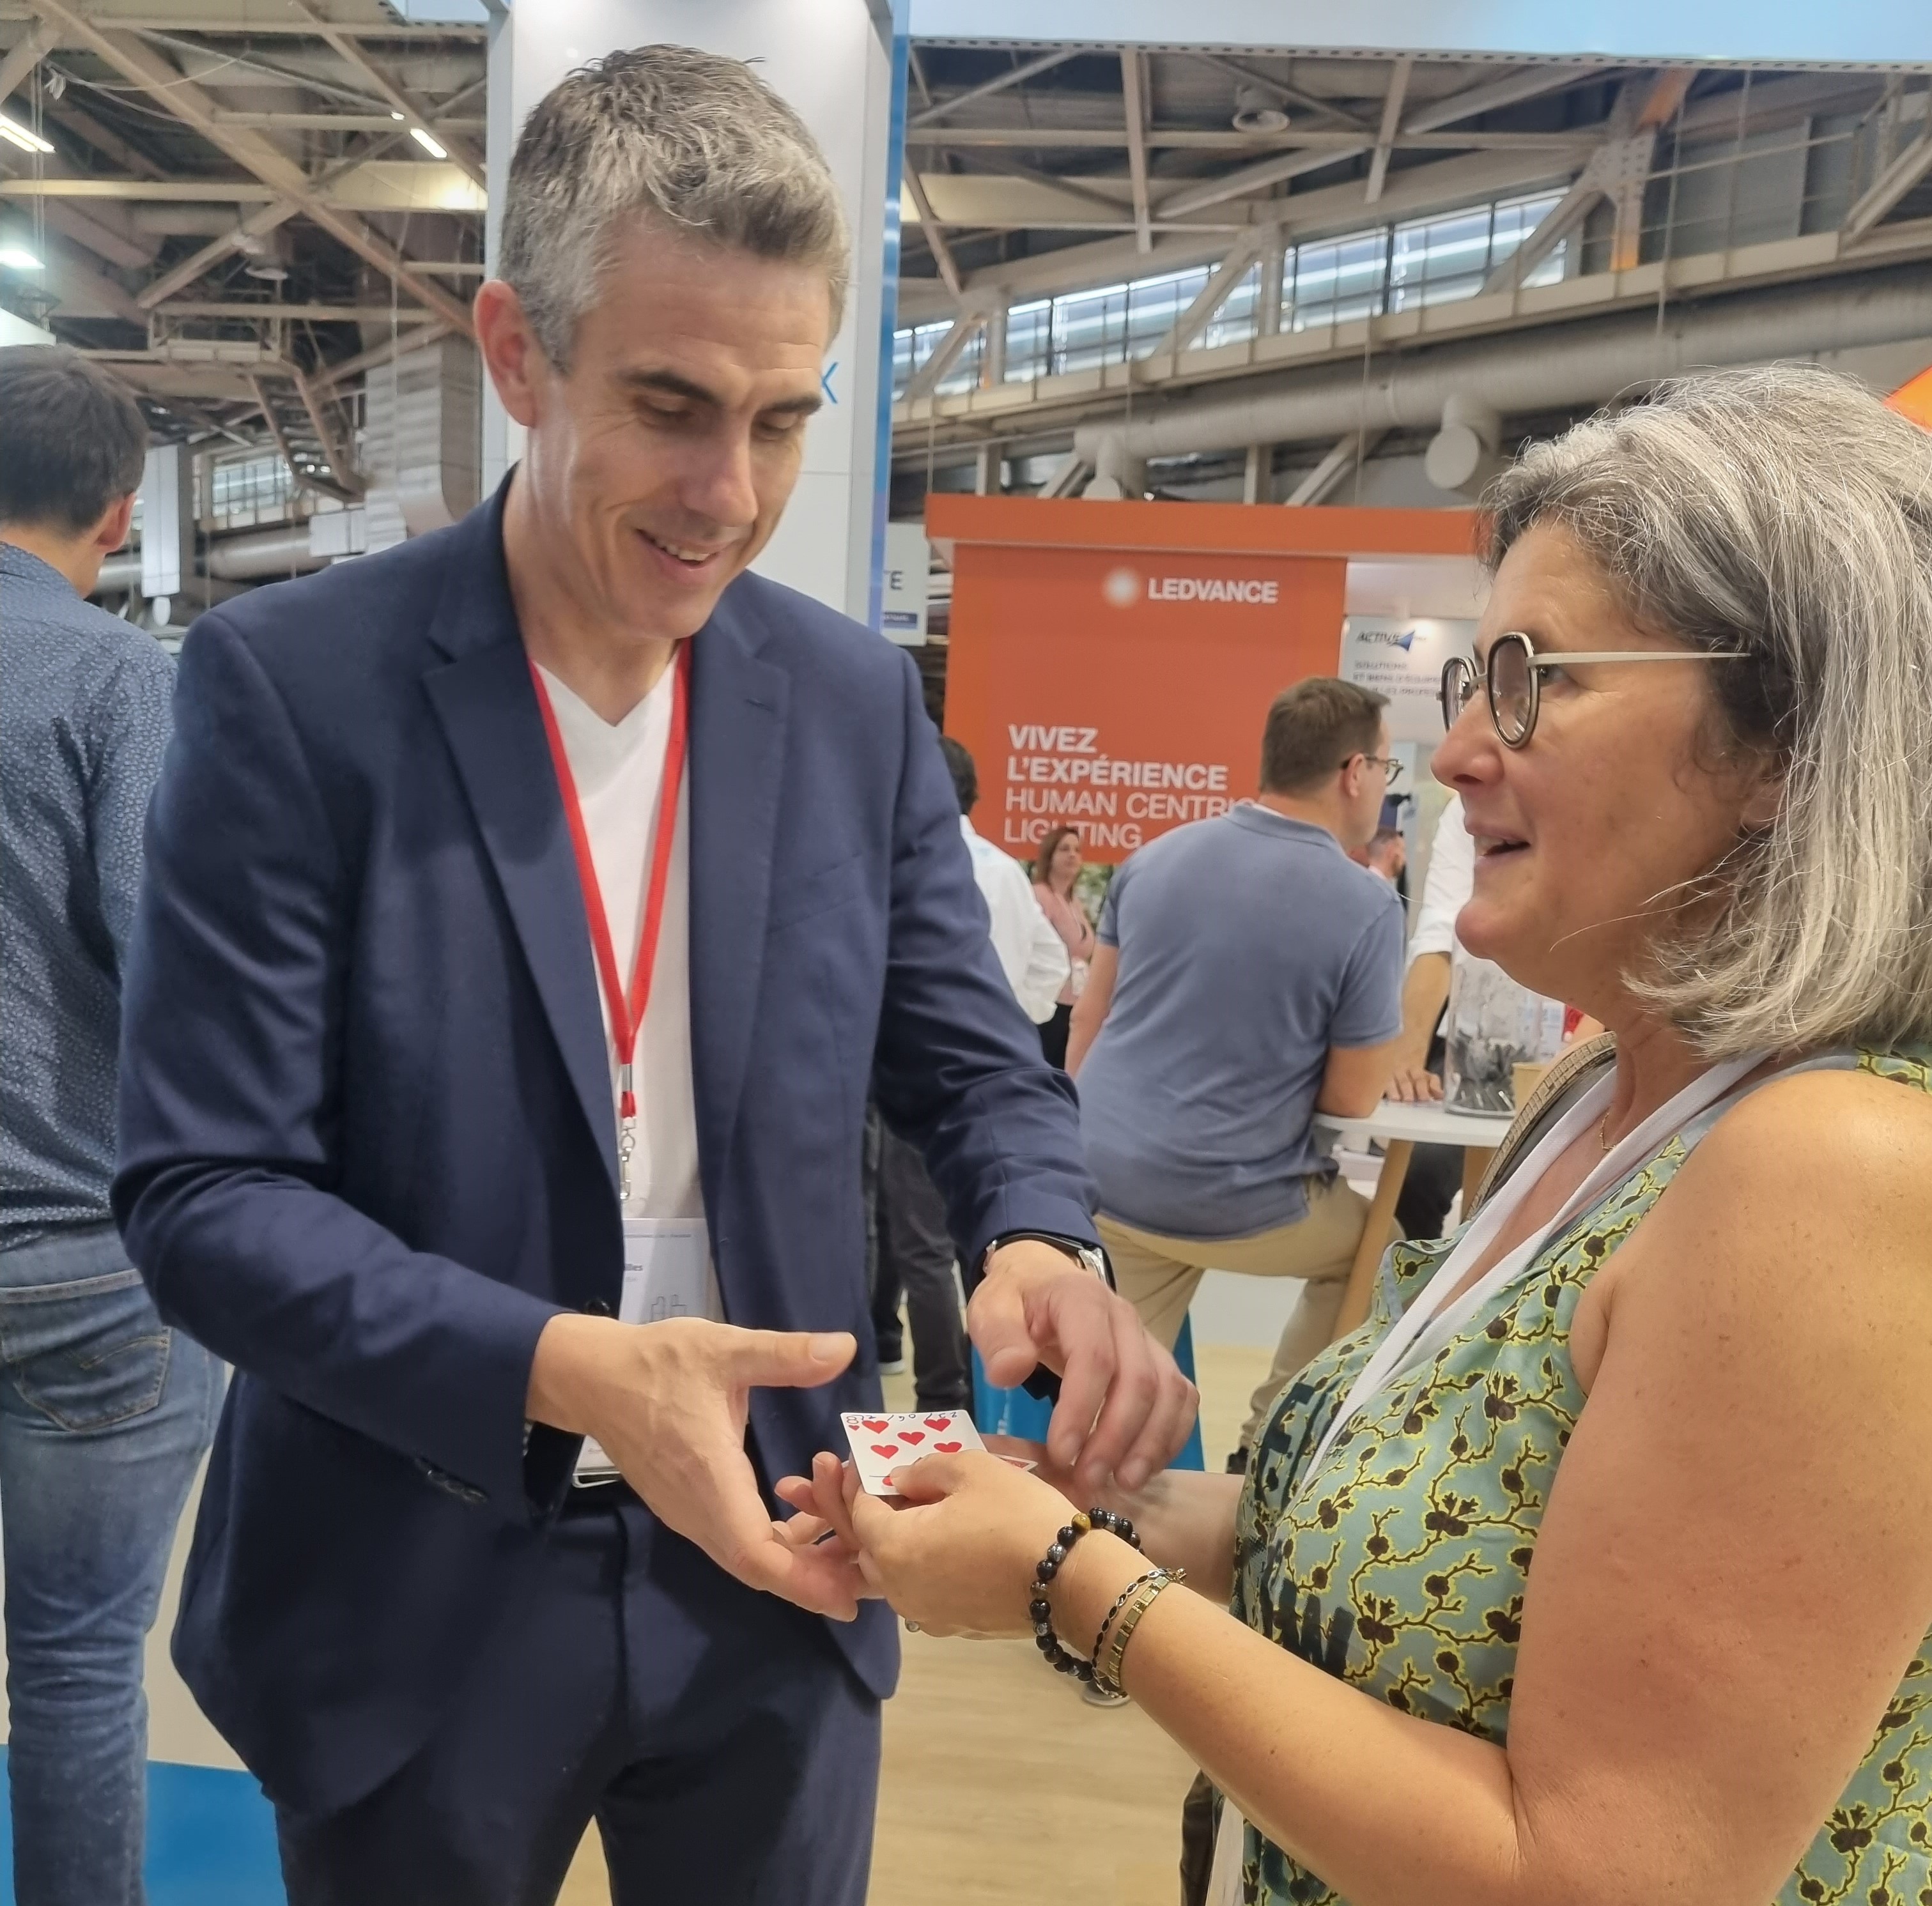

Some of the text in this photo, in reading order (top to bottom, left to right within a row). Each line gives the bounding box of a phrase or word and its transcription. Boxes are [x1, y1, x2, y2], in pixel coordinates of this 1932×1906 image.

[1148, 577, 1279, 604] LEDVANCE
[1008, 723, 1099, 753] VIVEZ
[1006, 754, 1229, 791] L'EXPÉRIENCE
[1005, 787, 1118, 817] HUMAN
[1004, 817, 1143, 849] LIGTING
